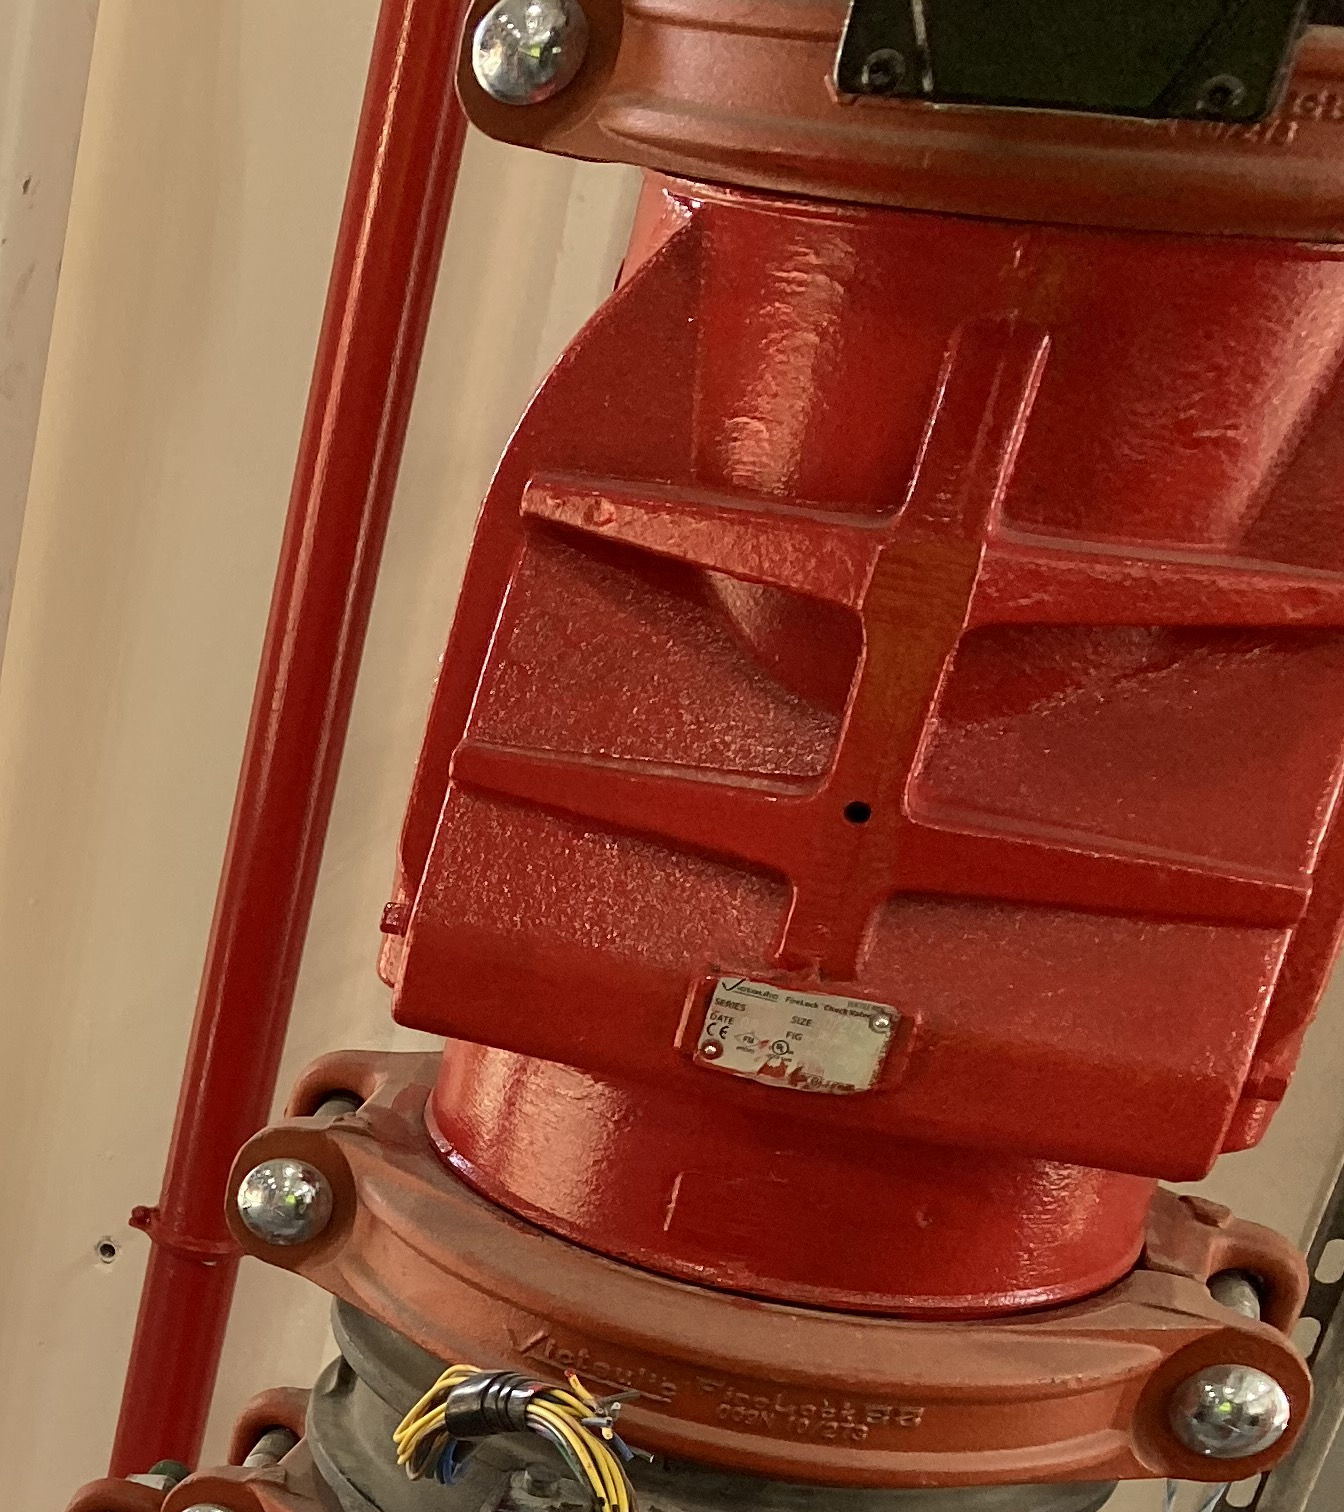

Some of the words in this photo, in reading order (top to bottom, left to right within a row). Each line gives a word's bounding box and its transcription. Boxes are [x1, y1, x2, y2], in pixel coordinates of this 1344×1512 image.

[715, 997, 747, 1012] SERIES
[709, 1012, 735, 1026] DATE
[790, 1015, 813, 1027] SIZE
[706, 1022, 730, 1040] CE
[785, 1030, 804, 1042] FIG
